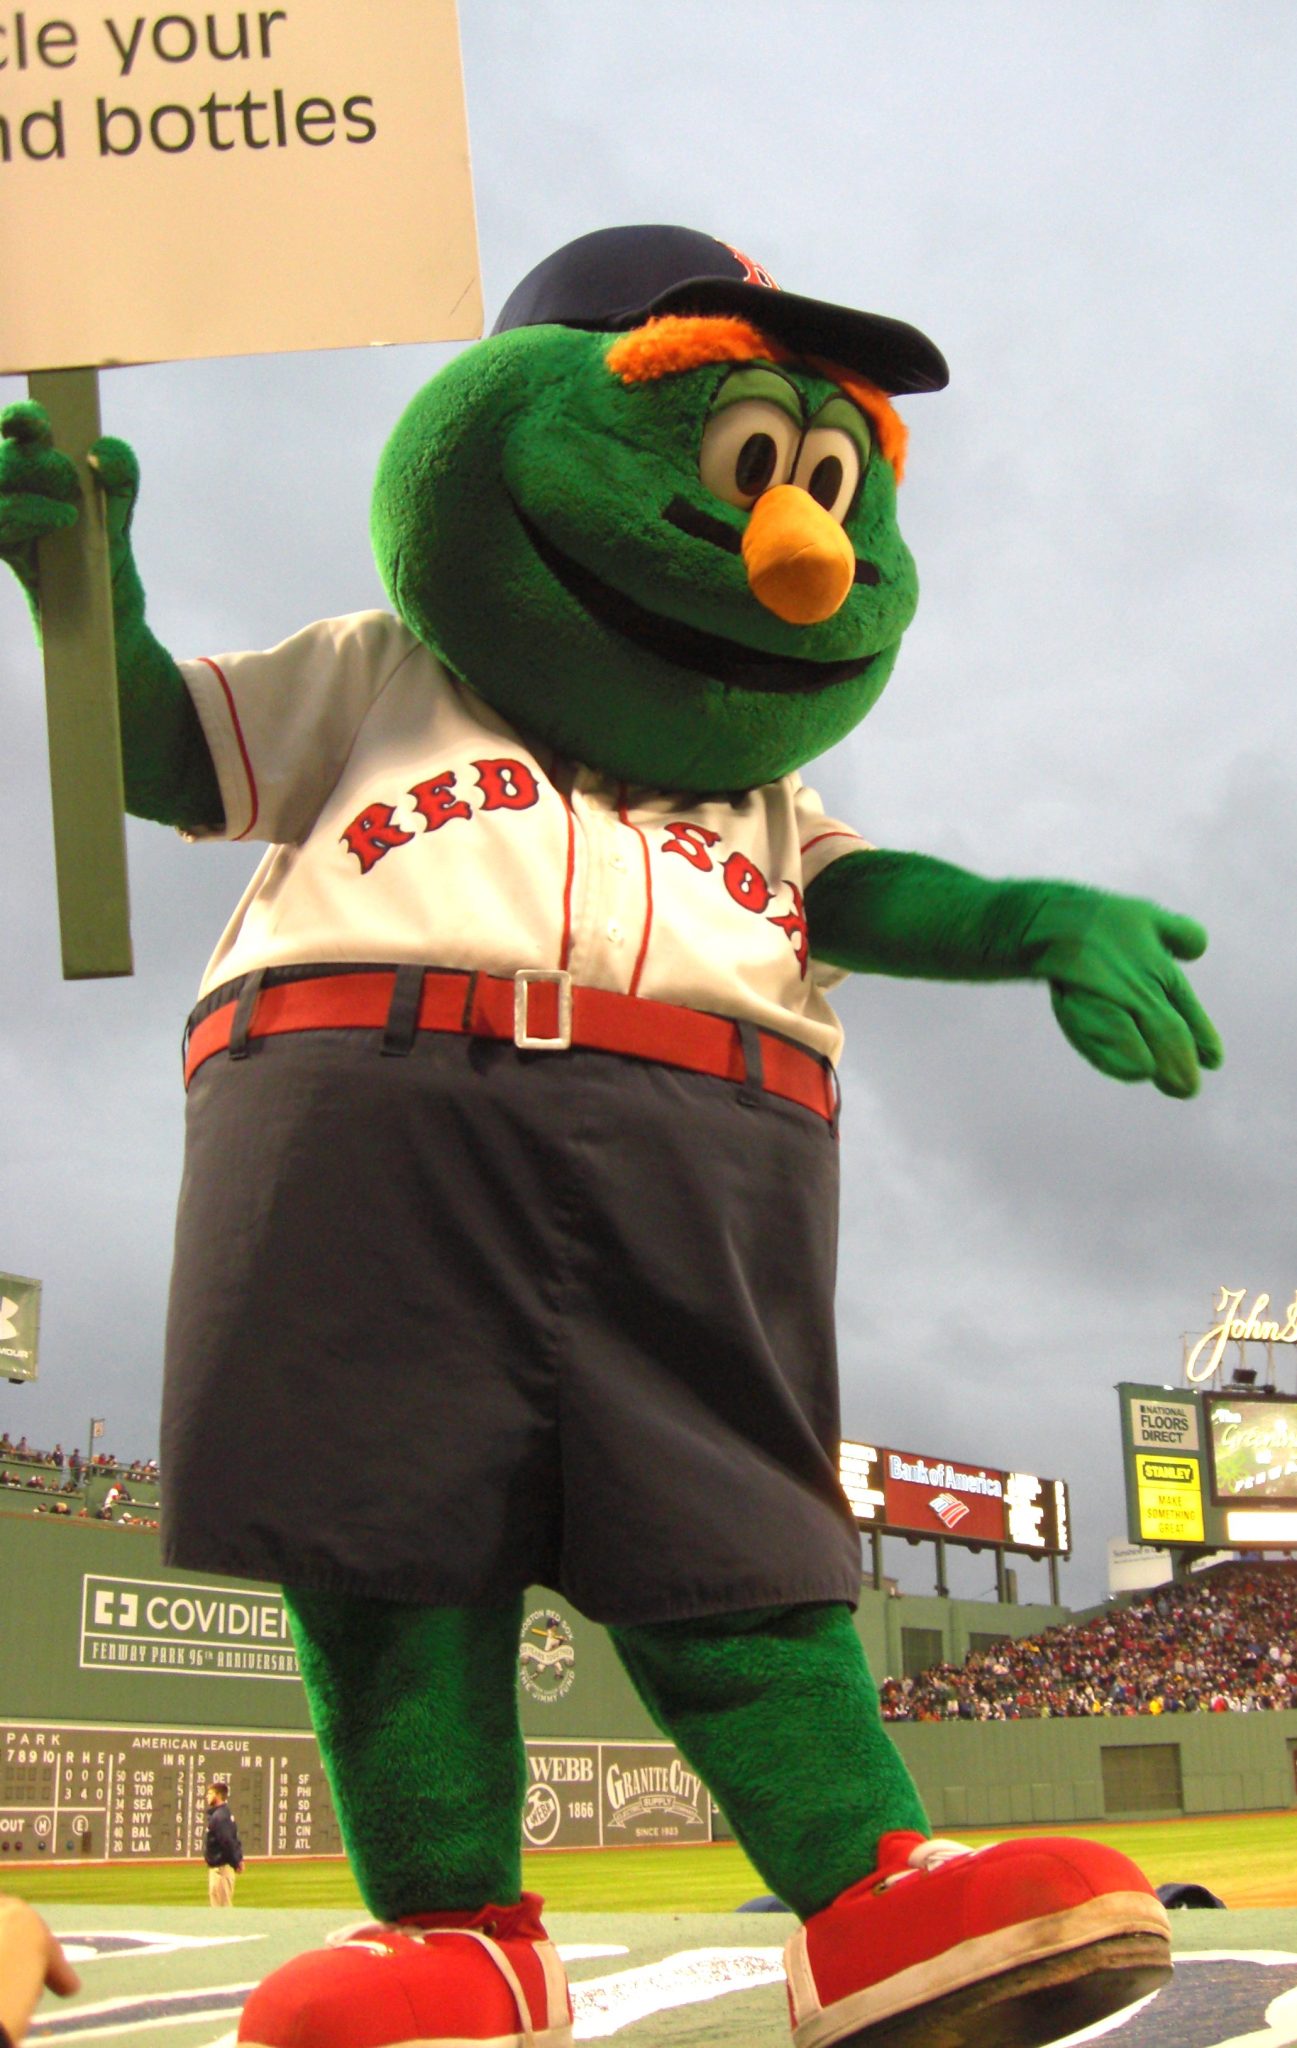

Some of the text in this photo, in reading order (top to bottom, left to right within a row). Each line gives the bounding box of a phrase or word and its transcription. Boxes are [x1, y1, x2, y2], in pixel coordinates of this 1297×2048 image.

[0, 9, 287, 76] le your
[97, 89, 377, 156] bottles
[340, 758, 808, 981] RED SOX
[1187, 1286, 1280, 1382] John
[1146, 1405, 1187, 1417] NATIONAL
[1141, 1415, 1189, 1431] FLOORS
[1142, 1429, 1184, 1443] DIRECT
[889, 1454, 929, 1485] Bank
[929, 1463, 945, 1486] of
[944, 1465, 1002, 1498] America
[1144, 1464, 1192, 1480] STANLEY
[1158, 1495, 1182, 1507] MAKE
[1147, 1508, 1196, 1521] SOMETHING
[1159, 1523, 1184, 1534] GREAT
[146, 1596, 287, 1639] COVIDIE
[92, 1641, 147, 1663] FENWAY
[151, 1646, 185, 1665] PARK
[132, 1738, 250, 1751] AMERICAN LEAGUE
[8, 1749, 55, 1763] 7 8 9 10
[66, 1751, 105, 1764] R H E
[118, 1753, 185, 1766] P IN R
[198, 1755, 262, 1767] P IN R
[281, 1757, 288, 1768] P
[65, 1769, 104, 1781] 0 0 0
[528, 1756, 594, 1782] WEBB
[134, 1771, 154, 1782] CWS
[178, 1771, 184, 1783] 2
[213, 1773, 232, 1784] DET
[298, 1774, 310, 1784] SF
[134, 1785, 153, 1796] TOR
[606, 1759, 701, 1810] GRANITE CITY
[64, 1788, 72, 1800] 3
[297, 1786, 311, 1797] PHI
[133, 1799, 152, 1810] SEA
[298, 1800, 310, 1811] SD
[568, 1802, 594, 1818] 1866
[132, 1813, 152, 1824] NYY
[295, 1812, 311, 1823] FLA
[0, 1819, 25, 1832] OUT
[296, 1825, 311, 1836] CIN
[131, 1827, 152, 1838] BAL
[635, 1827, 659, 1837] SINCE
[131, 1840, 151, 1852] LAA
[295, 1838, 311, 1849] ATL
